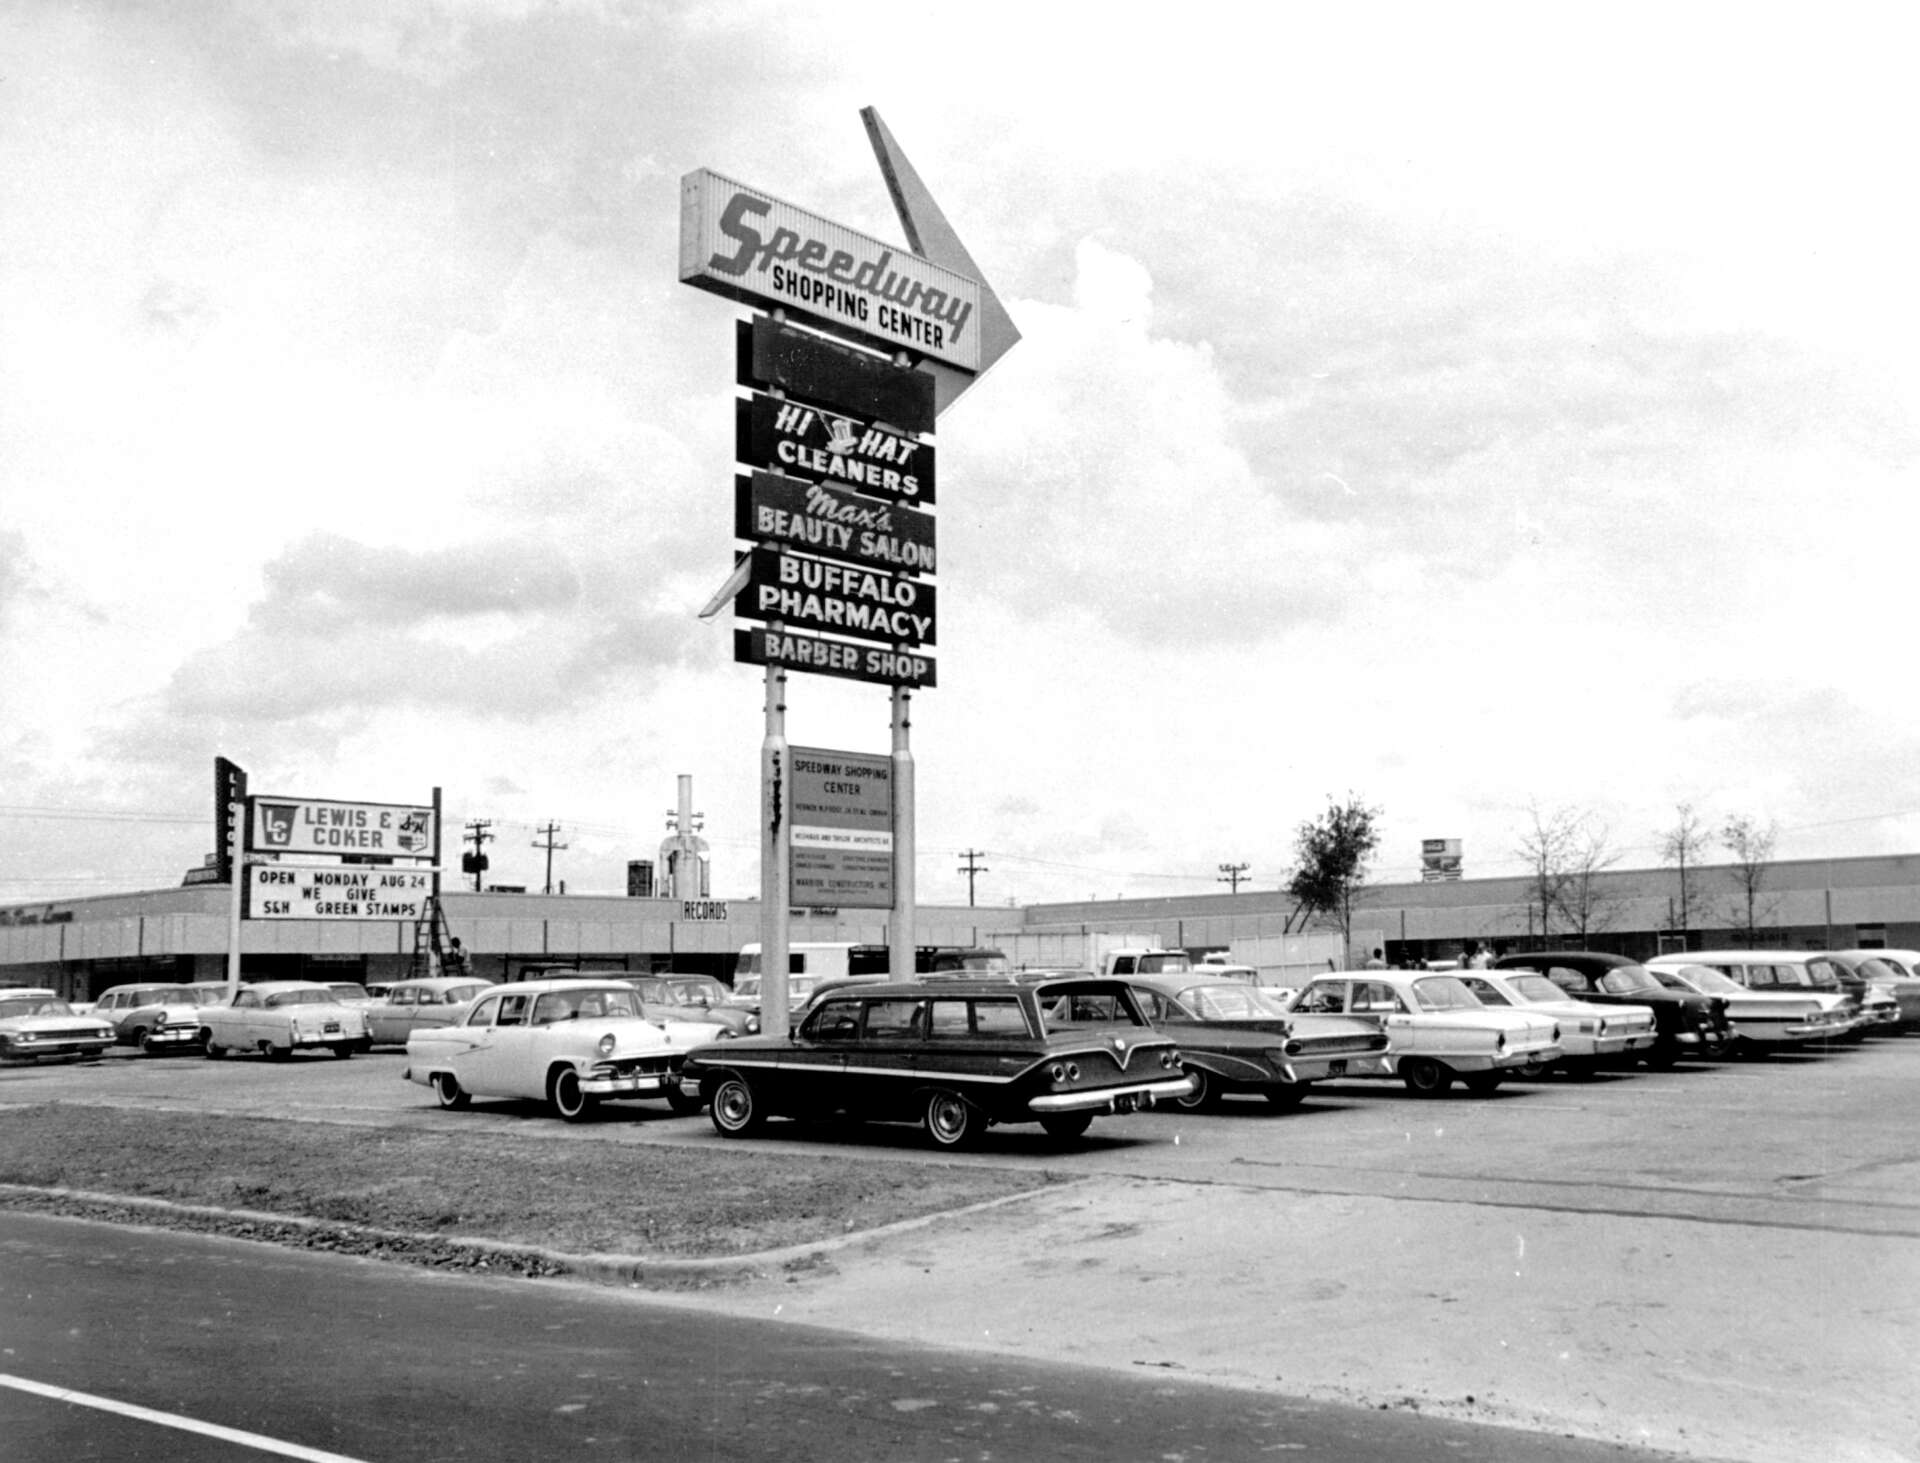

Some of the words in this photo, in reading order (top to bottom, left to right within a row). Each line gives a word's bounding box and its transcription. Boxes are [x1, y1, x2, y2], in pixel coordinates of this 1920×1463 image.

[708, 192, 973, 344] Speedway
[772, 265, 869, 321] SHOPPING
[878, 306, 944, 350] CENTER
[775, 404, 814, 437] HI
[858, 429, 919, 465] HAT
[777, 440, 919, 496] CLEANERS
[757, 504, 854, 551] BEAUTY
[860, 531, 935, 570] SALON
[779, 556, 916, 607] BUFFALO
[759, 584, 932, 640] PHARMACY
[764, 633, 858, 671] BARBER
[866, 651, 927, 680] SHOP
[795, 760, 842, 776] SPEEDWAY
[845, 765, 888, 780] SHOPPING
[823, 781, 861, 796] CENTER
[305, 807, 367, 828] LEWIS
[313, 828, 384, 849] COKER
[259, 871, 296, 886] OPEN
[314, 872, 369, 887] MONDAY
[380, 874, 405, 888] AUG
[410, 876, 426, 888] 24
[302, 887, 321, 900] WE
[346, 888, 376, 901] GIVE
[263, 901, 290, 914] S&H
[315, 902, 358, 915] GREEN
[366, 903, 416, 916] STAMPS
[684, 901, 727, 920] RECORDS
